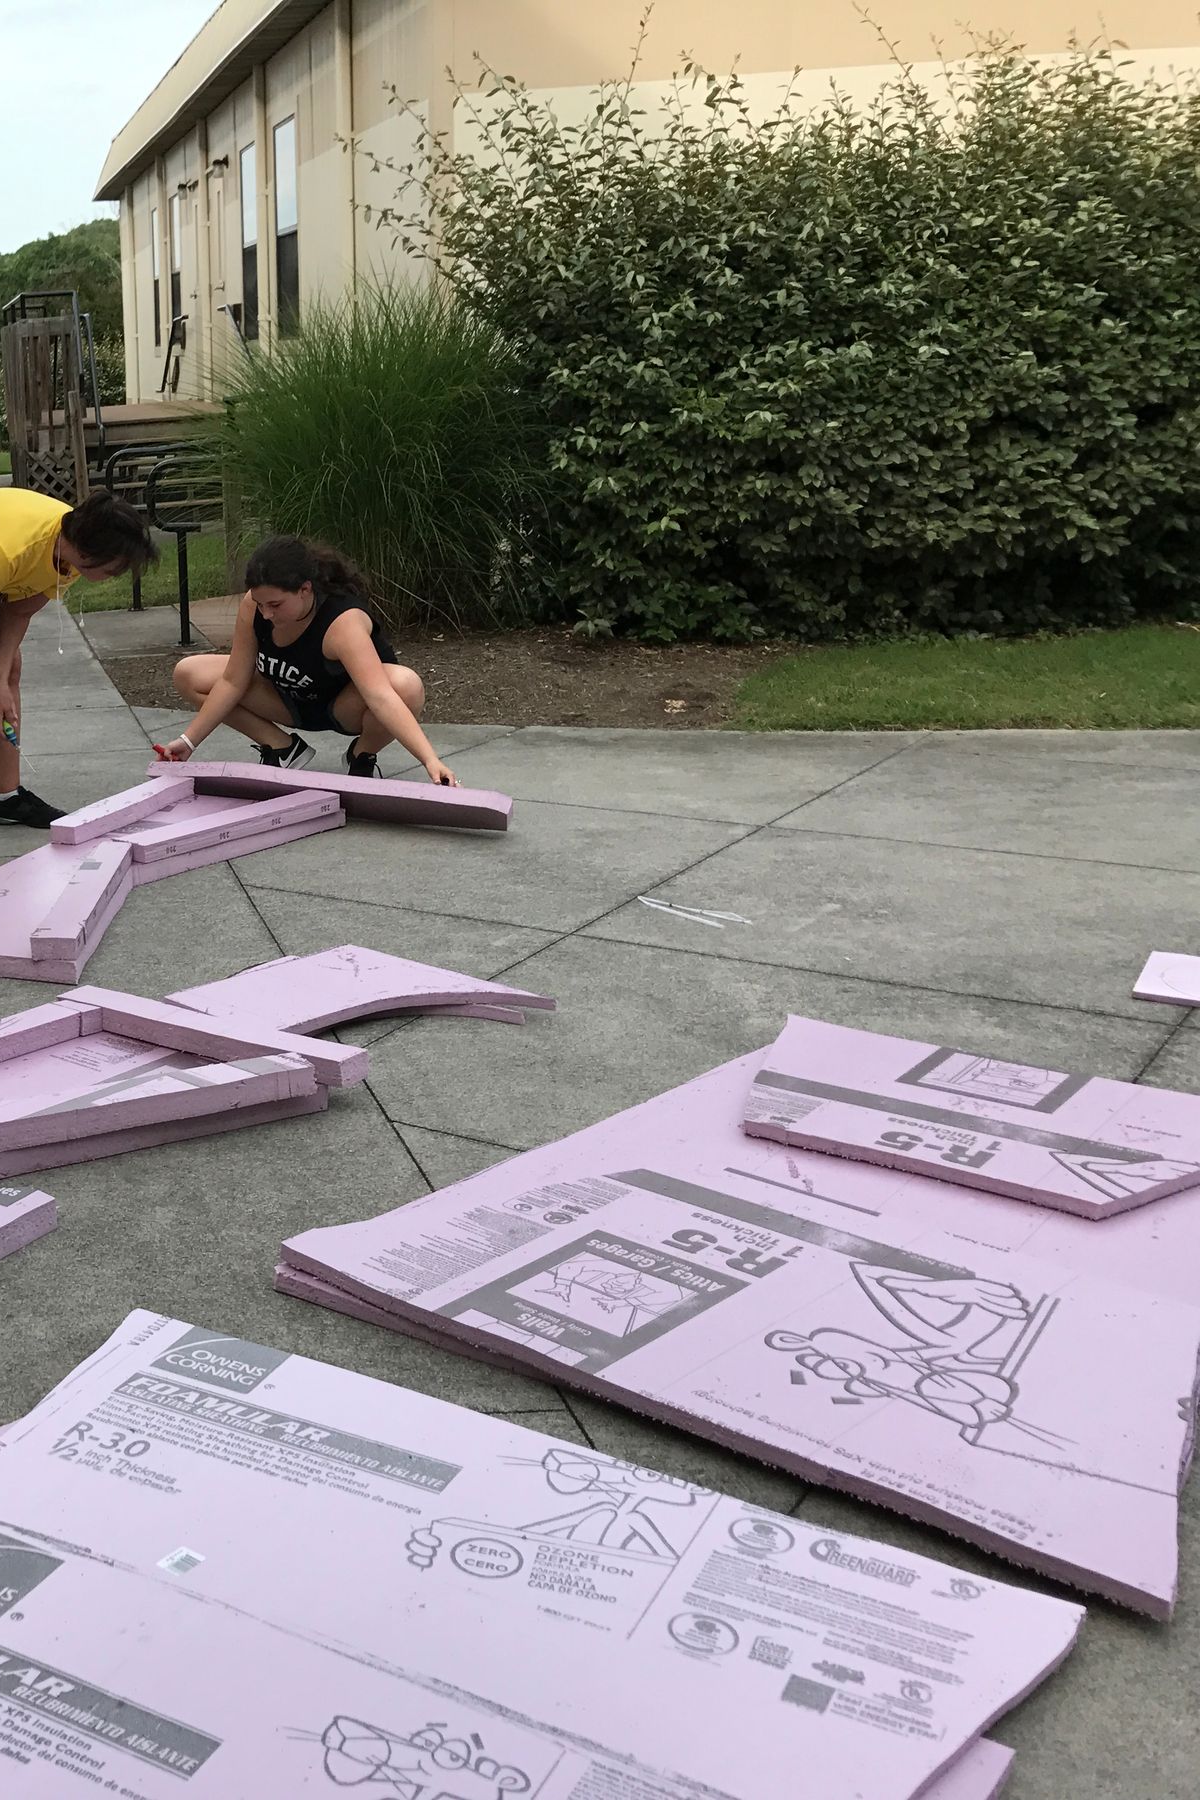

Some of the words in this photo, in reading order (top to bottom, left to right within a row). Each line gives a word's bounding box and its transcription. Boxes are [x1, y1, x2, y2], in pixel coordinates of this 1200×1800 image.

[256, 651, 314, 688] STICE
[873, 1130, 996, 1169] R-5
[690, 1211, 780, 1246] Thickness
[585, 1238, 656, 1268] Garages
[661, 1228, 790, 1279] R-5
[669, 1268, 727, 1292] Attics
[516, 1312, 566, 1338] Walls
[165, 1353, 258, 1387] CORNING
[191, 1349, 267, 1378] OWENS
[127, 1376, 332, 1443] FOAMULAR
[62, 1420, 151, 1458] R-3.0
[194, 1407, 267, 1435] SHEATHING
[381, 1463, 447, 1490] AISLANTE
[278, 1447, 301, 1460] XPS
[302, 1452, 356, 1477] Insulation
[832, 1447, 865, 1463] XPS
[109, 1466, 128, 1479] de
[116, 1457, 177, 1485] Thickness
[278, 1456, 322, 1476] Damage
[325, 1471, 370, 1490] Control
[328, 1480, 371, 1499] consumo
[463, 1557, 509, 1573] CERO
[466, 1543, 512, 1560] ZERO
[535, 1552, 634, 1578] DEPLETION
[537, 1544, 600, 1563] OZONE
[527, 1579, 556, 1592] CAPA
[575, 1589, 617, 1604] OZONO
[3, 1705, 32, 1723] XPS
[32, 1719, 93, 1751] Insulation
[11, 1686, 126, 1739] RECUBRIMIENTO
[125, 1733, 200, 1772] AISLANTE
[2, 1718, 52, 1748] Damage
[55, 1743, 107, 1771] Control
[37, 1749, 56, 1763] del
[54, 1757, 102, 1784] consumo
[103, 1779, 119, 1792] de
